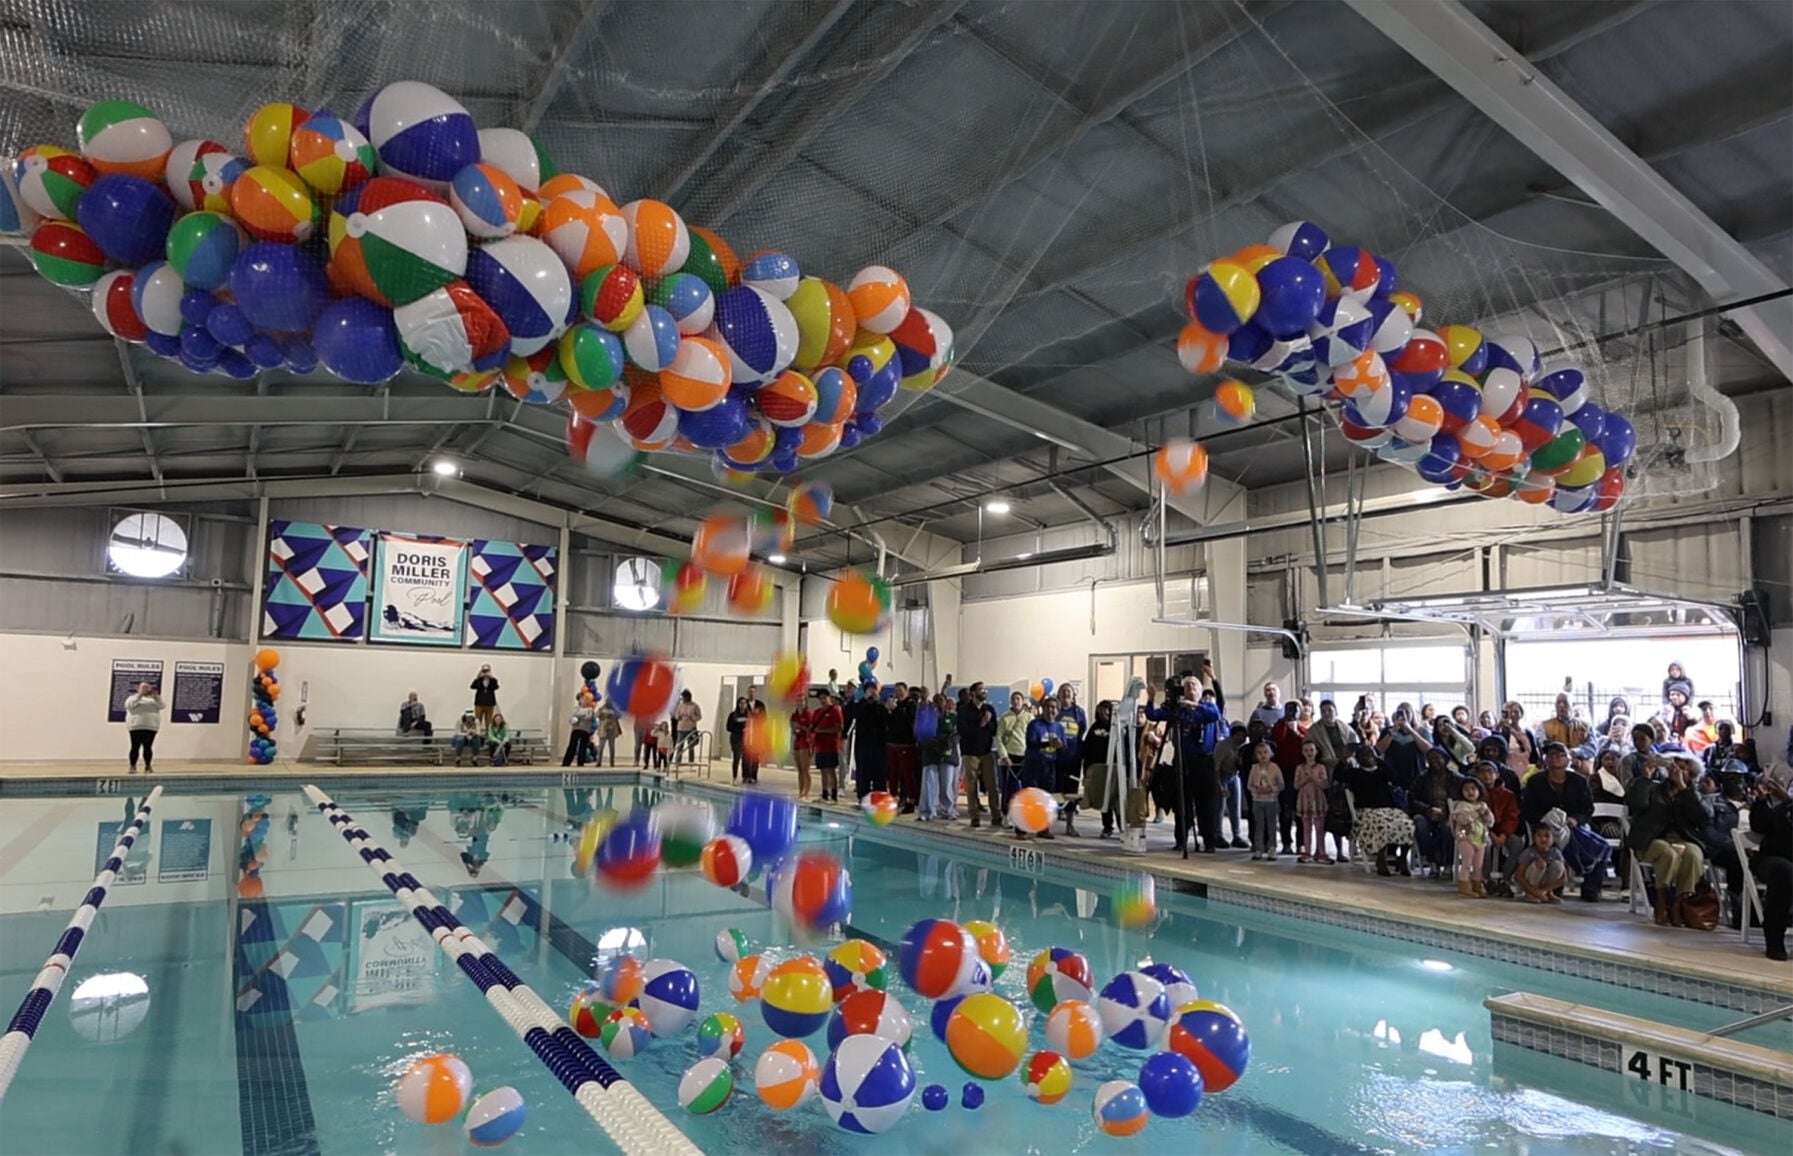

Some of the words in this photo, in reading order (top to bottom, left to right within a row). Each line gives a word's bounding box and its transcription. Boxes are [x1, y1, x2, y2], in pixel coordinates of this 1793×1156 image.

[397, 553, 447, 568] DORIS
[391, 565, 451, 579] MILLER
[390, 576, 451, 588] COMMUNITY
[406, 586, 453, 607] Pool
[1628, 1050, 1652, 1081] 4
